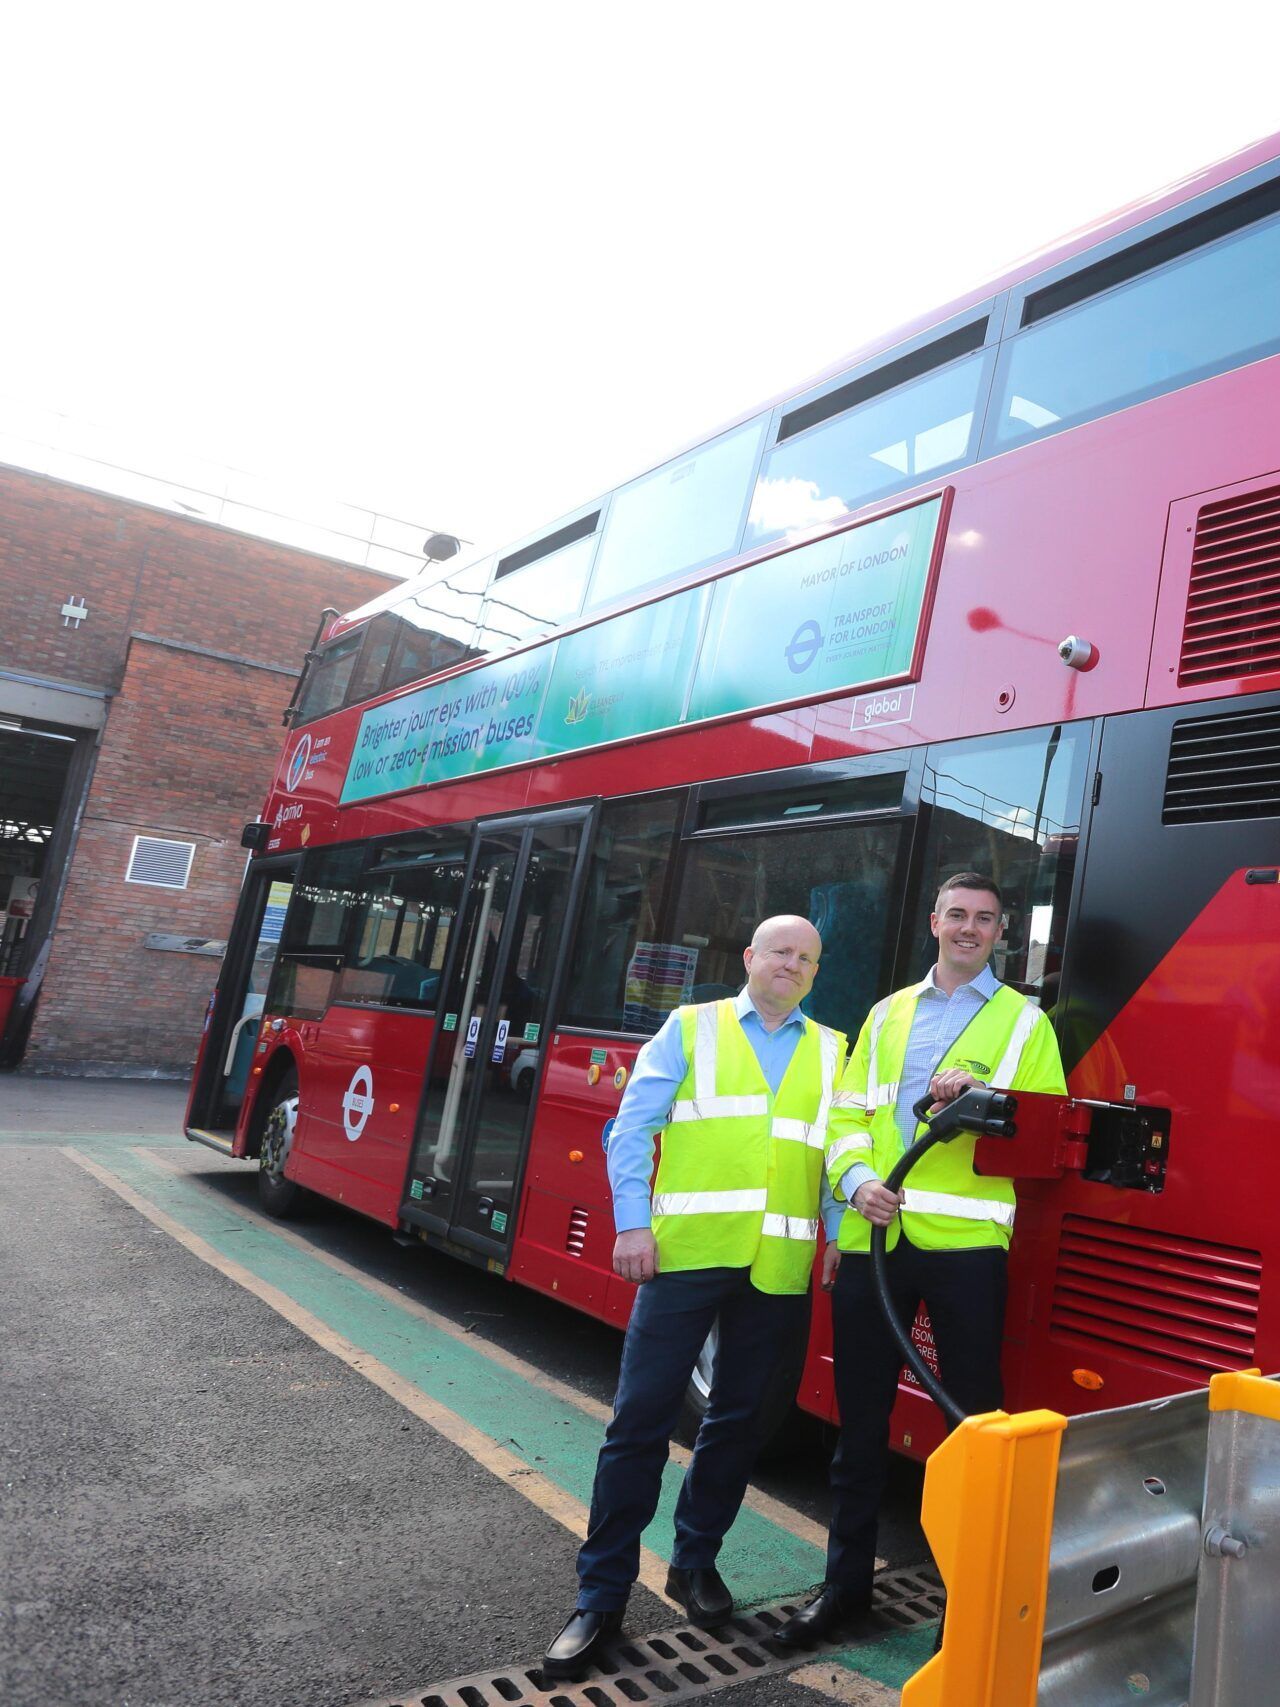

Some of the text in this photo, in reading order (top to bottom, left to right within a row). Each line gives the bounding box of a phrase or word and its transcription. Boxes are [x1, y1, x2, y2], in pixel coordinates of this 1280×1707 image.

[800, 544, 909, 589] MAYOR OF LONDON
[829, 618, 897, 646] FOR LONDON
[834, 602, 894, 627] TRANSPORT
[361, 718, 407, 750] Brighter
[465, 681, 498, 714] with
[500, 665, 541, 703] 100%
[864, 694, 901, 723] global
[353, 760, 373, 781] low
[375, 756, 388, 775] or
[485, 713, 535, 746] buses
